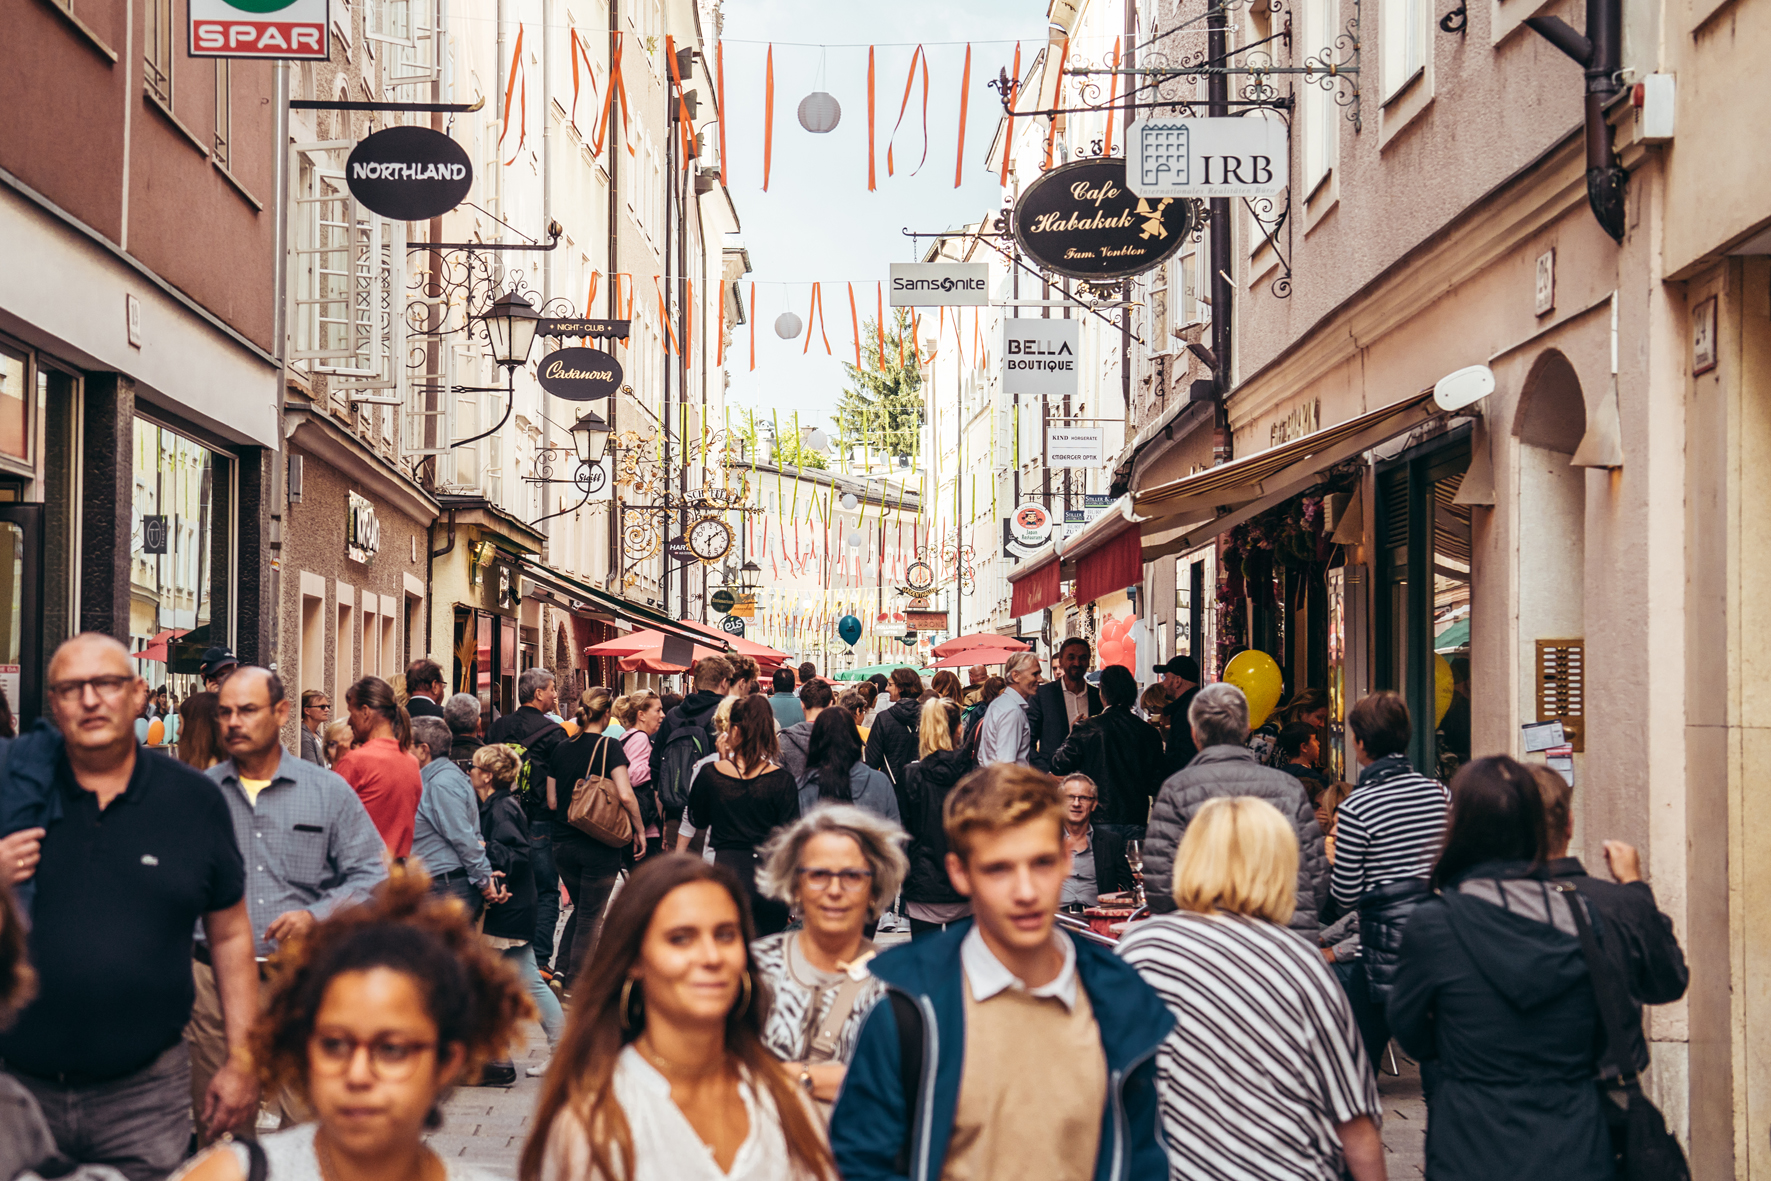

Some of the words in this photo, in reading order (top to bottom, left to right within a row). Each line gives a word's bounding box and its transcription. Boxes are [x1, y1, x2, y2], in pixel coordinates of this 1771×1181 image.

[198, 24, 320, 50] SPAR
[353, 162, 466, 180] NORTHLAND
[1200, 155, 1273, 185] IRB
[1070, 180, 1121, 207] Cafe
[1139, 187, 1204, 195] Internationales
[1208, 187, 1251, 195] Realitäten
[1030, 208, 1135, 233] Habakuk
[1064, 247, 1096, 260] Fam.
[893, 277, 985, 292] Samsonite
[1008, 339, 1073, 355] BELLA
[546, 360, 613, 382] Casanova
[1008, 360, 1073, 372] BOUTIQUE
[724, 619, 744, 631] eis
